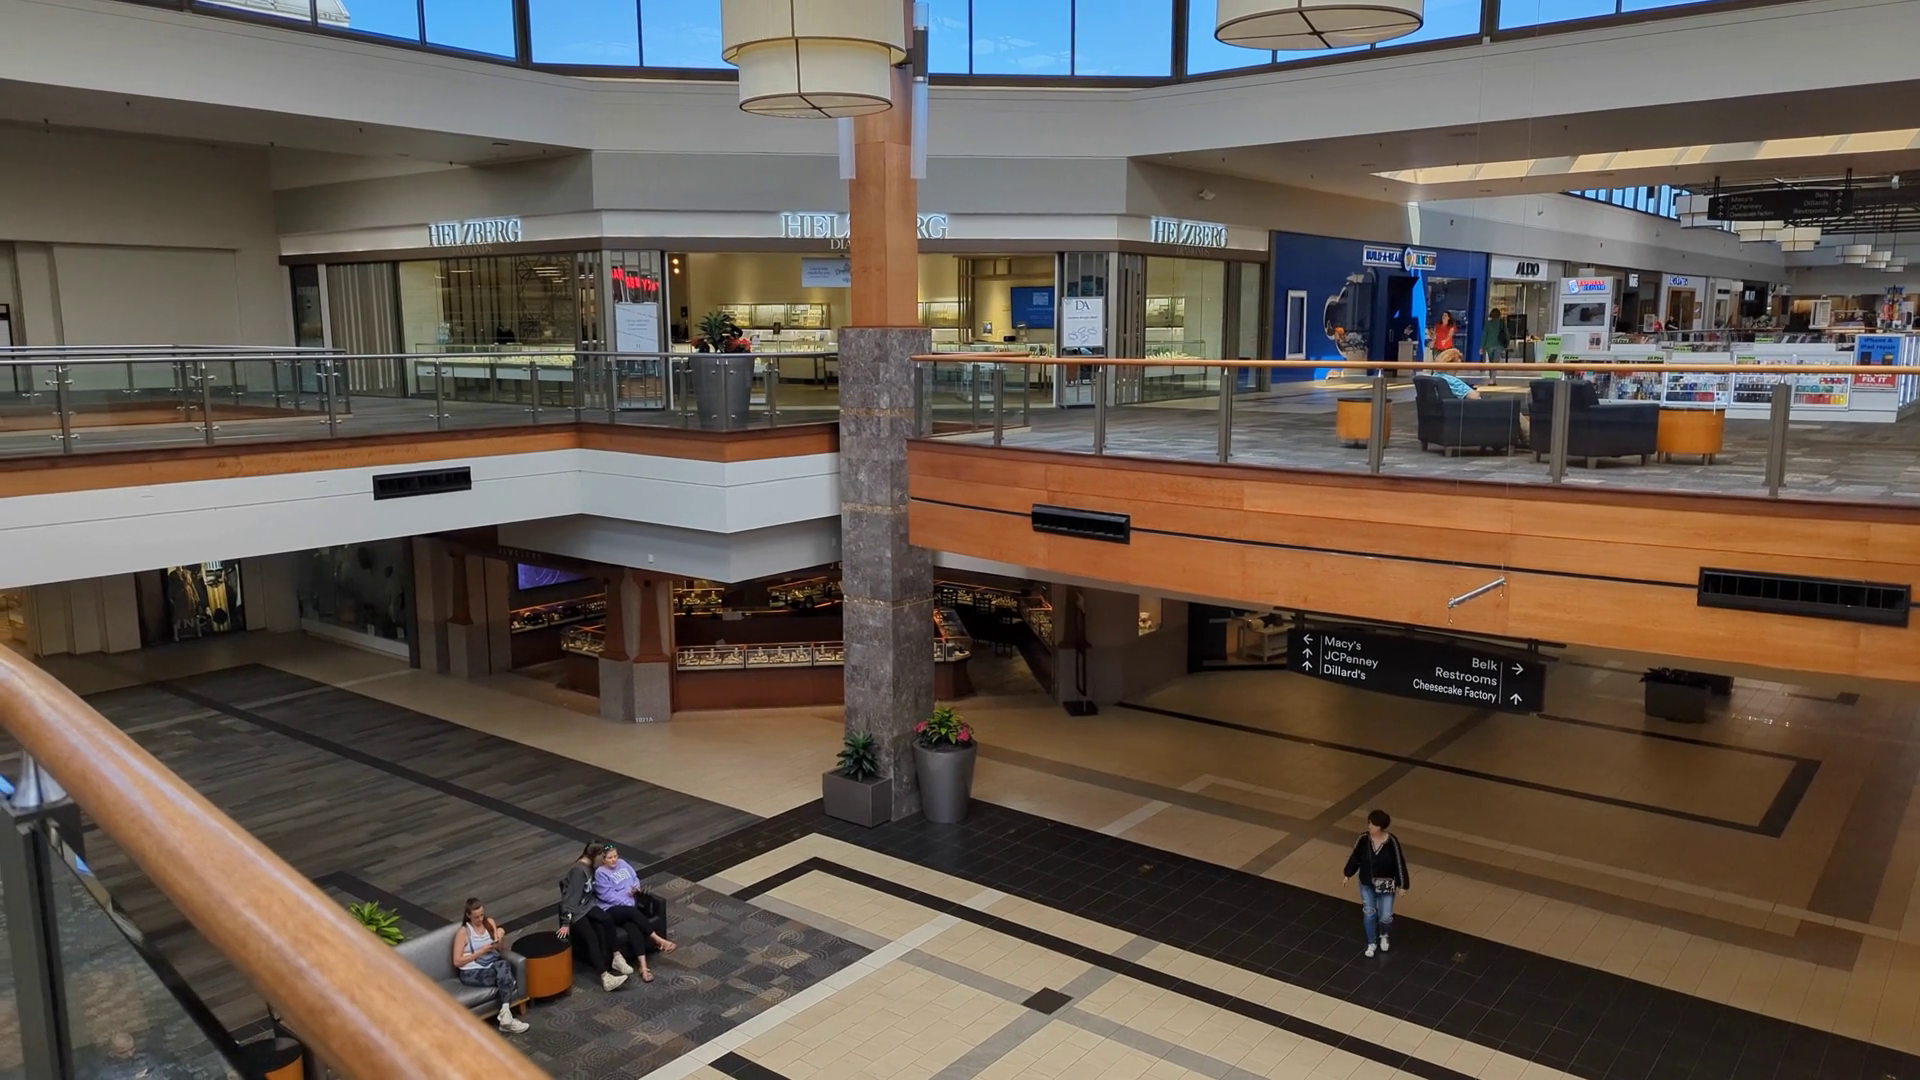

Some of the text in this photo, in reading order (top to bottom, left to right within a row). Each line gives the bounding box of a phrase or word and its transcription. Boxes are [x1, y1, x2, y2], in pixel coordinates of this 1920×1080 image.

[428, 219, 521, 247] HELZBERG
[1150, 220, 1229, 248] HELZBERG
[1515, 262, 1540, 275] ALDO
[1324, 635, 1362, 651] Macy's
[1324, 650, 1379, 669] JCPenney
[1472, 657, 1498, 671] Belk
[1323, 664, 1366, 680] Dillard's
[1435, 667, 1498, 686] Restrooms
[1413, 678, 1497, 704] Cheesecake Factory
